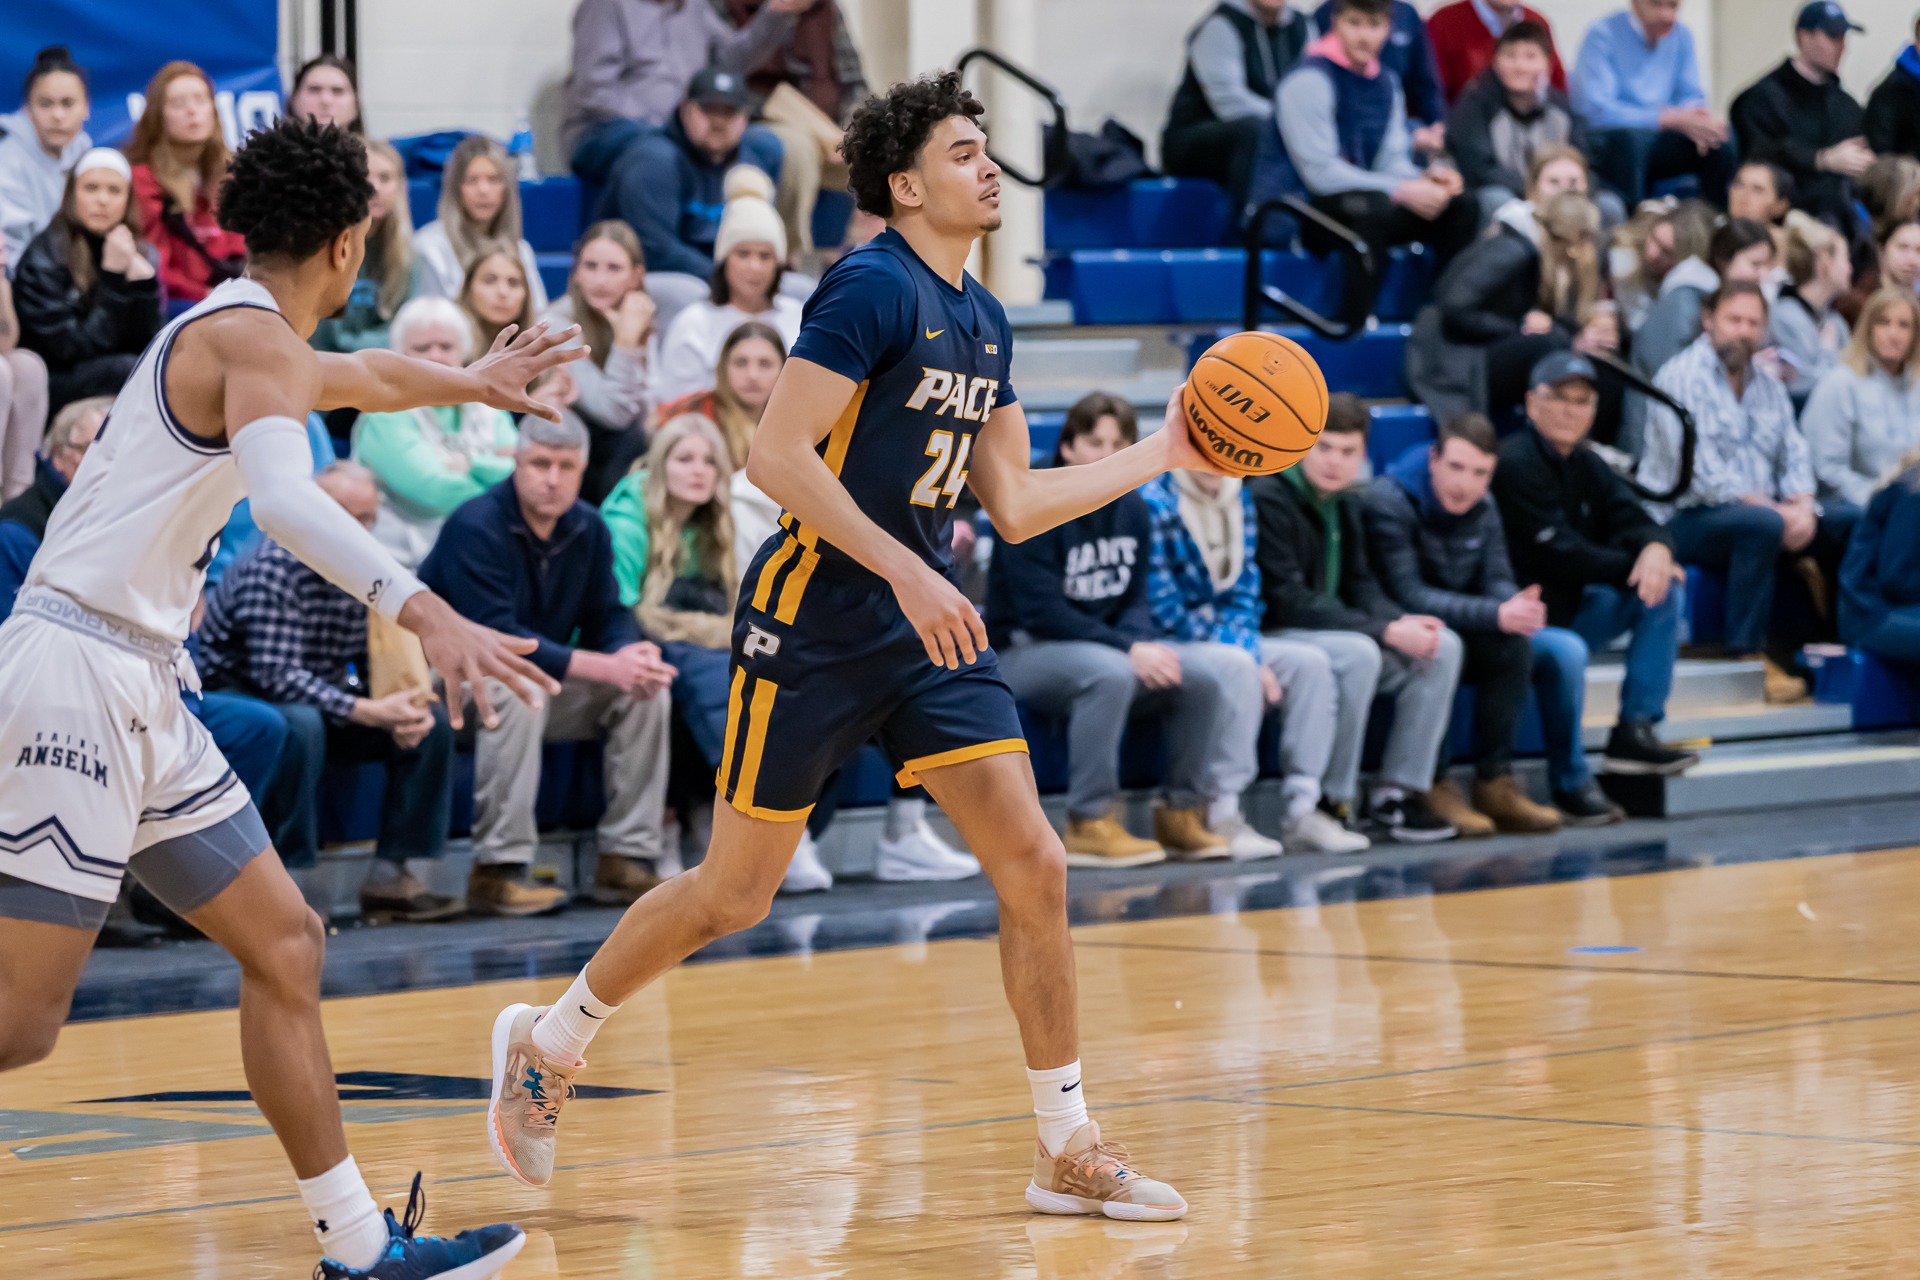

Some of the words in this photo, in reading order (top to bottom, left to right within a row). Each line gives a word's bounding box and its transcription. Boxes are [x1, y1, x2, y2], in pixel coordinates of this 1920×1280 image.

[904, 367, 999, 423] PACE
[1217, 383, 1271, 424] EVO
[909, 429, 972, 509] 24
[742, 621, 781, 660] P
[35, 732, 99, 755] SAINT
[15, 746, 108, 788] ANSELM
